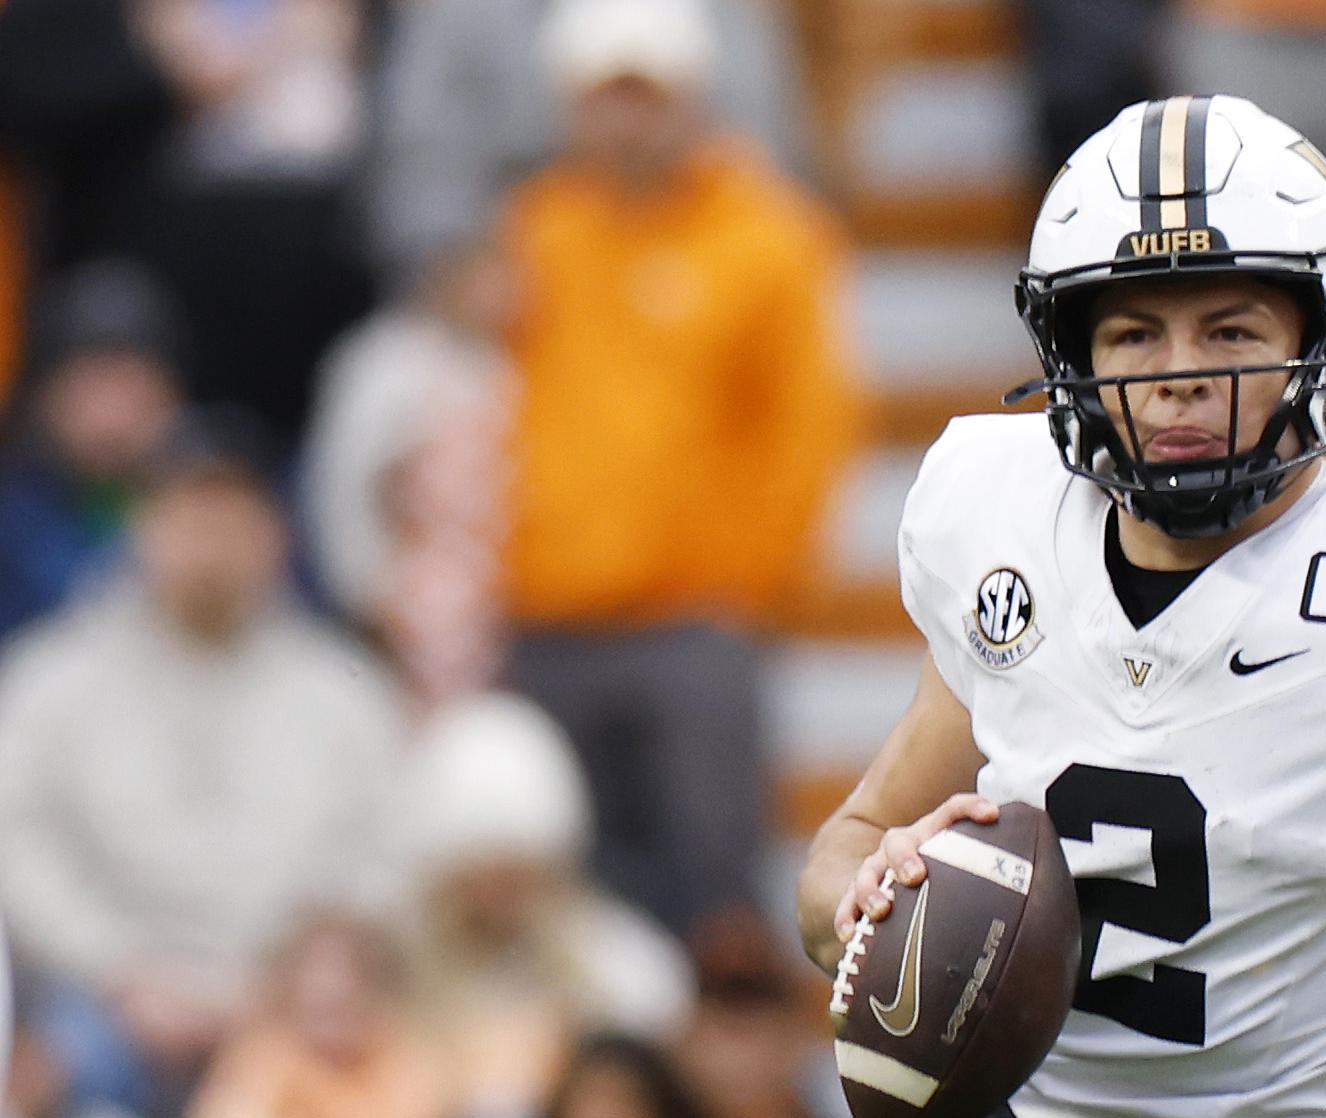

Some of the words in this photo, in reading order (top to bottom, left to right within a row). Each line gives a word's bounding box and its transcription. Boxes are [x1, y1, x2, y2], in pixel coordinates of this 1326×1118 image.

[1130, 229, 1212, 257] VUFB
[979, 570, 1030, 644] SEC
[968, 630, 1026, 666] GRADUATE
[1045, 762, 1211, 1048] 2
